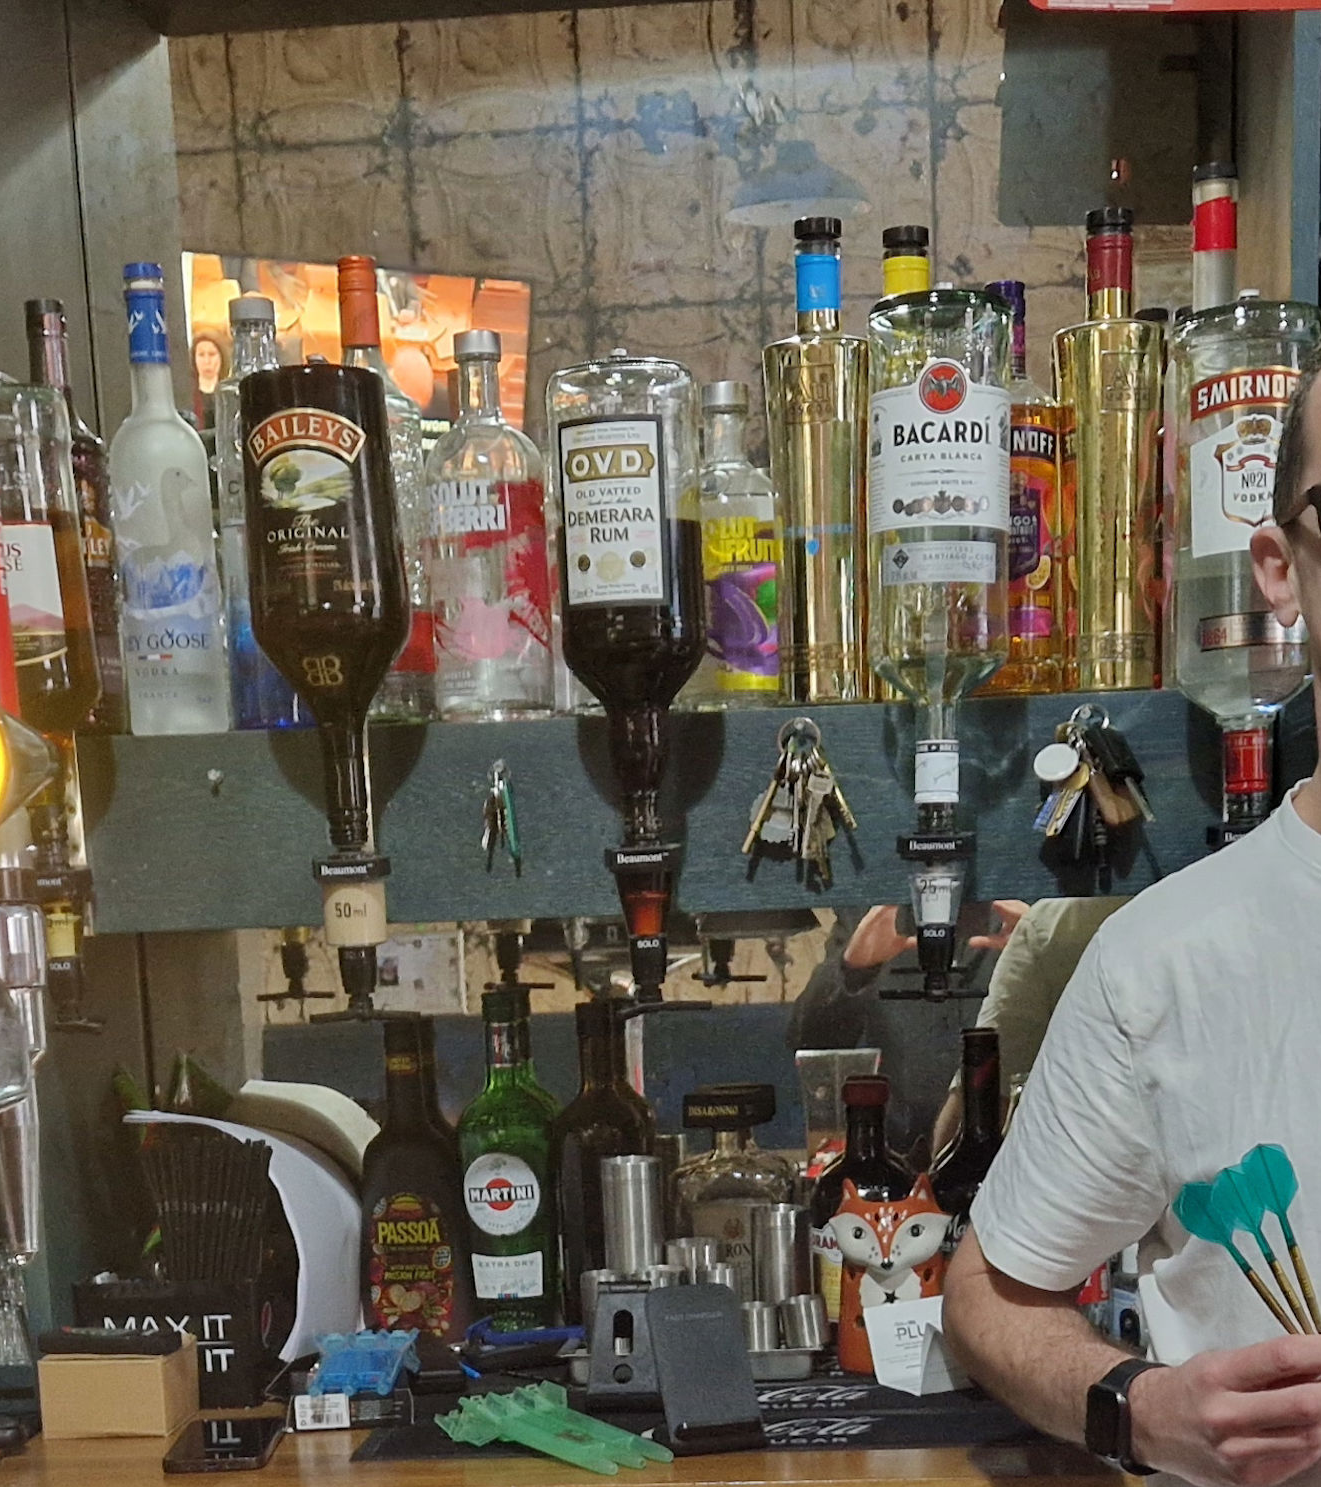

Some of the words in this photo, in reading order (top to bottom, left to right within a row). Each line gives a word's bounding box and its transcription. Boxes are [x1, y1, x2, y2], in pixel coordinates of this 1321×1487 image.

[1197, 374, 1297, 411] SMIRNOF
[253, 413, 357, 455] BAILEYS
[900, 453, 935, 463] CARTA
[940, 452, 982, 461] BLANCA
[576, 489, 595, 499] OLD
[600, 486, 641, 496] VATTED
[292, 515, 319, 527] The
[568, 507, 655, 528] DEMERARA
[267, 527, 349, 544] ORIGINAL
[589, 527, 630, 544] RUM
[147, 628, 209, 650] GOOSE
[909, 839, 956, 851] Beaumont
[616, 851, 664, 865] Beaumont
[320, 863, 368, 877] Beaumont
[923, 929, 946, 938] SOLO
[637, 938, 660, 949] SOLO
[688, 1105, 739, 1117] DISARONNO
[469, 1185, 534, 1203] MARTINI
[478, 1260, 510, 1269] EXTRA
[515, 1259, 535, 1268] DRY
[104, 1314, 190, 1335] MAX
[203, 1314, 231, 1340] IT
[894, 1326, 928, 1341] PLU
[206, 1348, 235, 1373] IT
